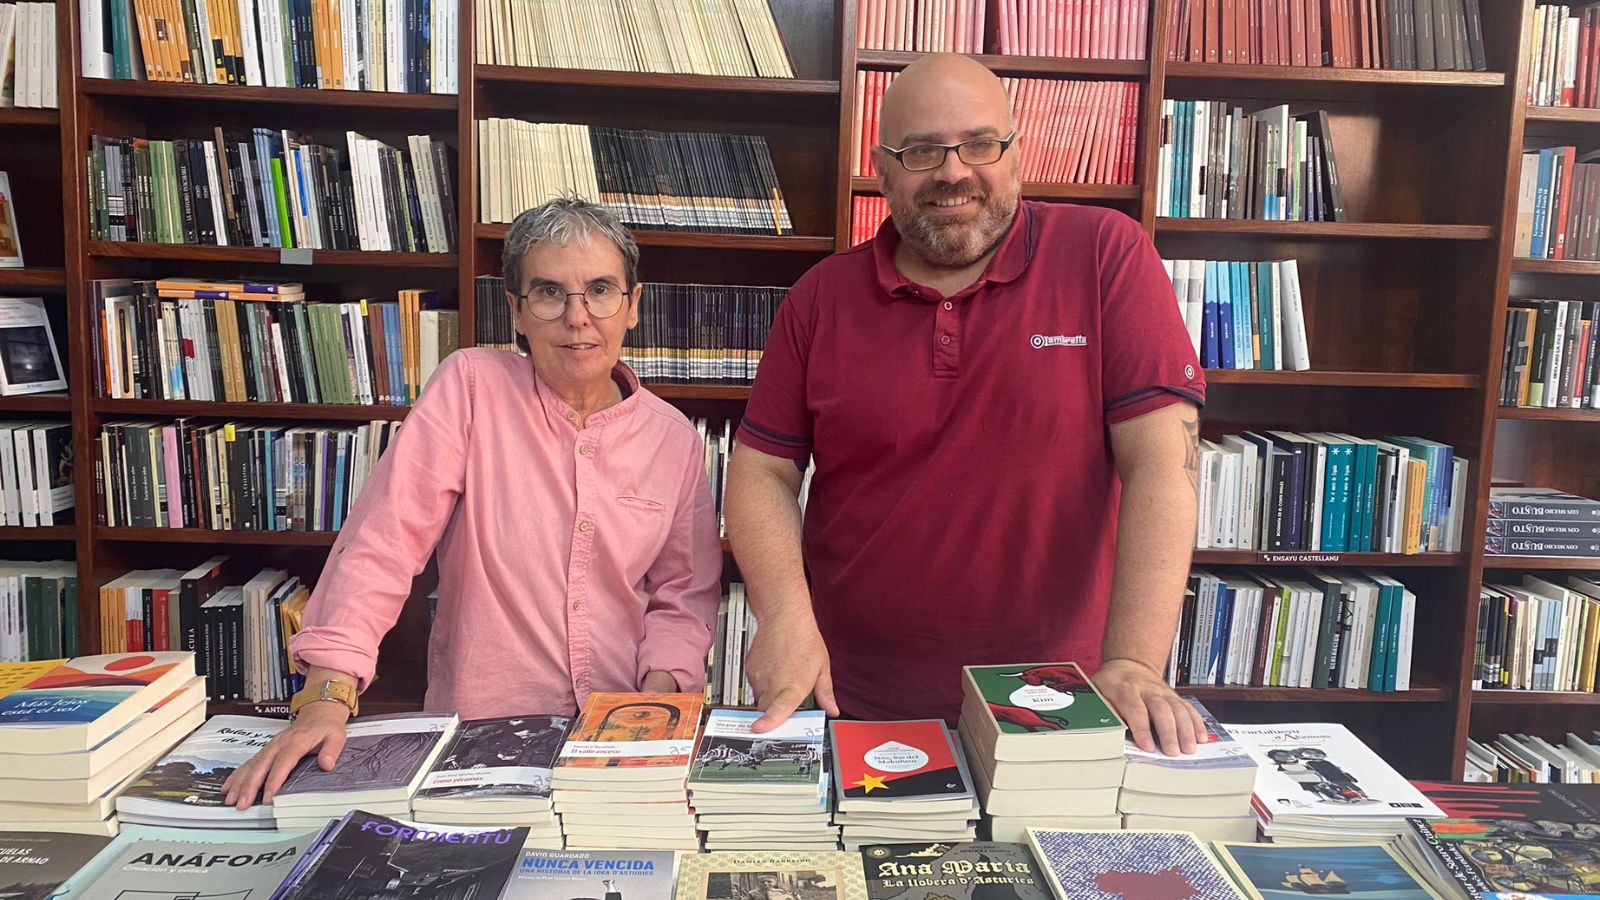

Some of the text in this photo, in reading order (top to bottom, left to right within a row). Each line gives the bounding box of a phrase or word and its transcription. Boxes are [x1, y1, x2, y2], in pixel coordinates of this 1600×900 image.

[1512, 505, 1544, 515] BUSTO
[1513, 524, 1545, 534] BUSTO
[1512, 541, 1544, 551] BUSTO
[14, 698, 90, 708] Más lejos
[1, 705, 82, 716] está el sol
[361, 820, 513, 845] FORMIENTU
[0, 856, 50, 864] DE ARNAO
[128, 846, 297, 868] ANÁFORA
[522, 858, 654, 870] NUNCA VENCIDA
[878, 859, 1031, 878] Ana María
[882, 876, 1035, 888] La llobera d'Asturies
[1472, 875, 1491, 893] ndrés
